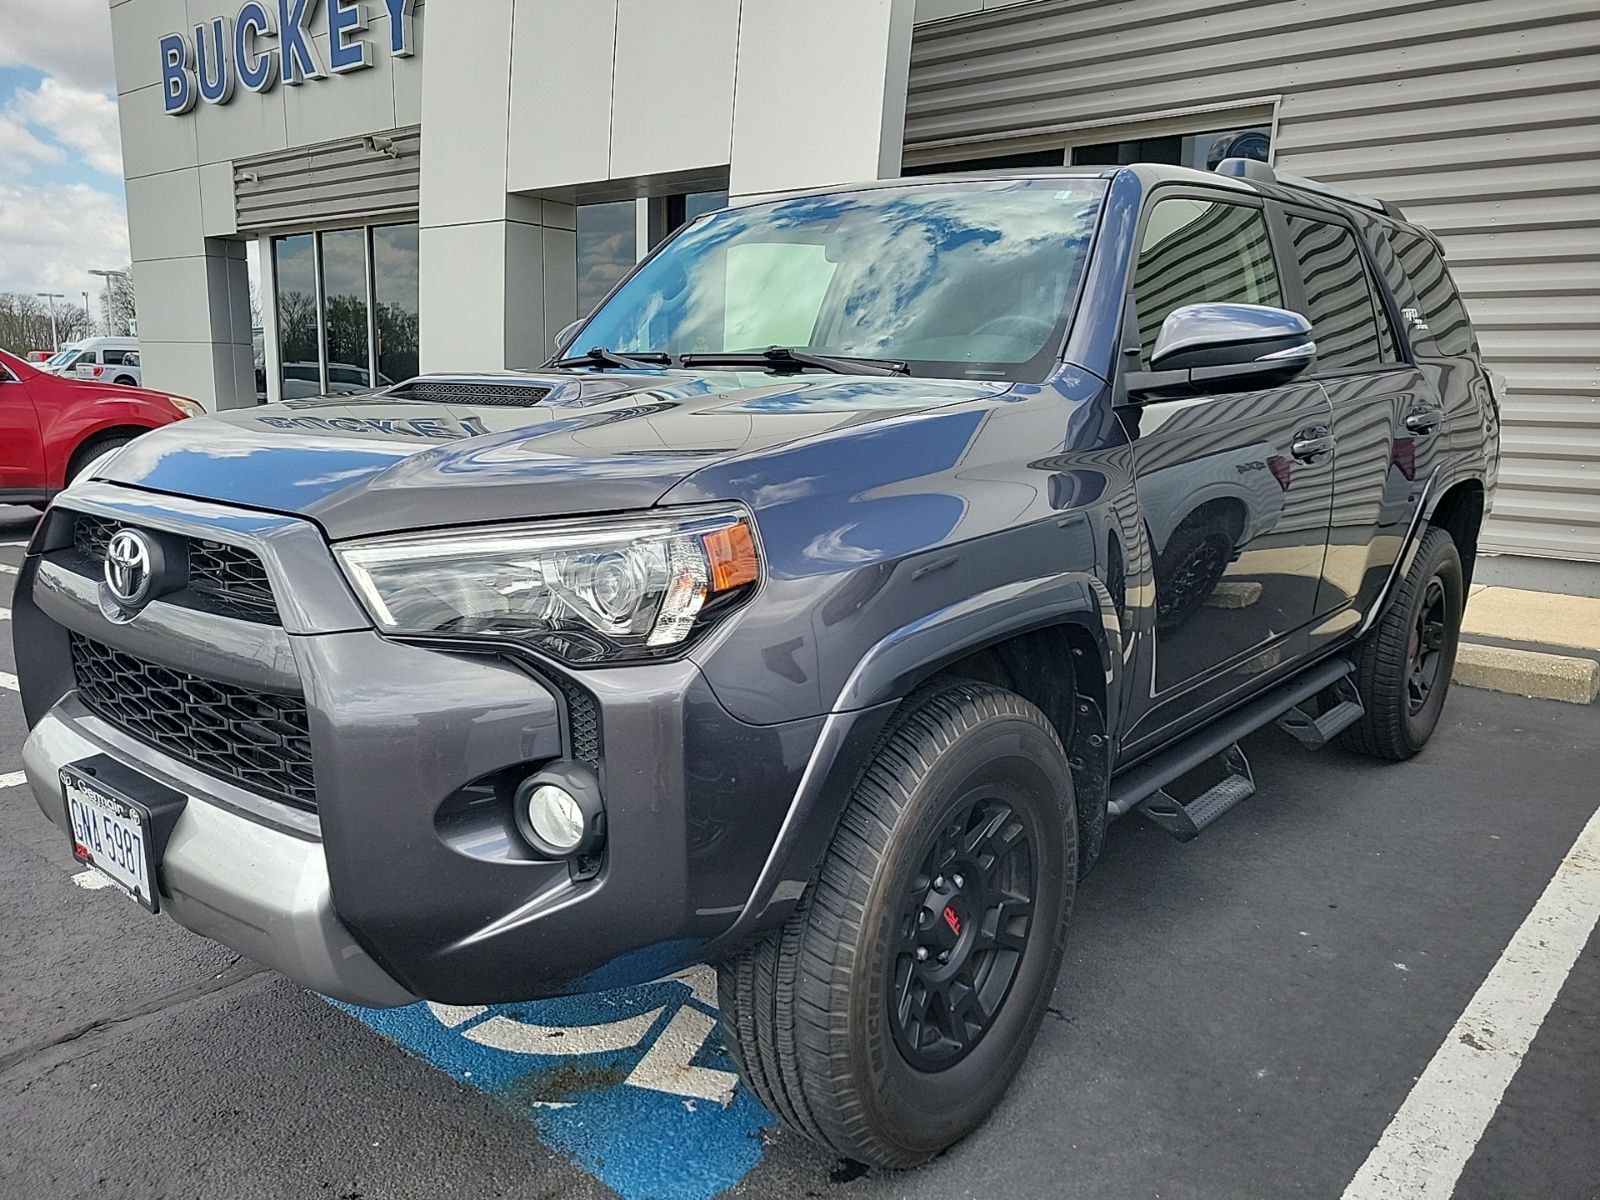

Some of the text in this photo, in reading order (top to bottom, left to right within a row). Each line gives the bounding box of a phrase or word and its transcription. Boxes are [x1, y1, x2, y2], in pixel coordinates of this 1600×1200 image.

[158, 0, 415, 116] BUCKEY
[77, 779, 124, 814] Germain
[71, 798, 143, 881] GNA 5987
